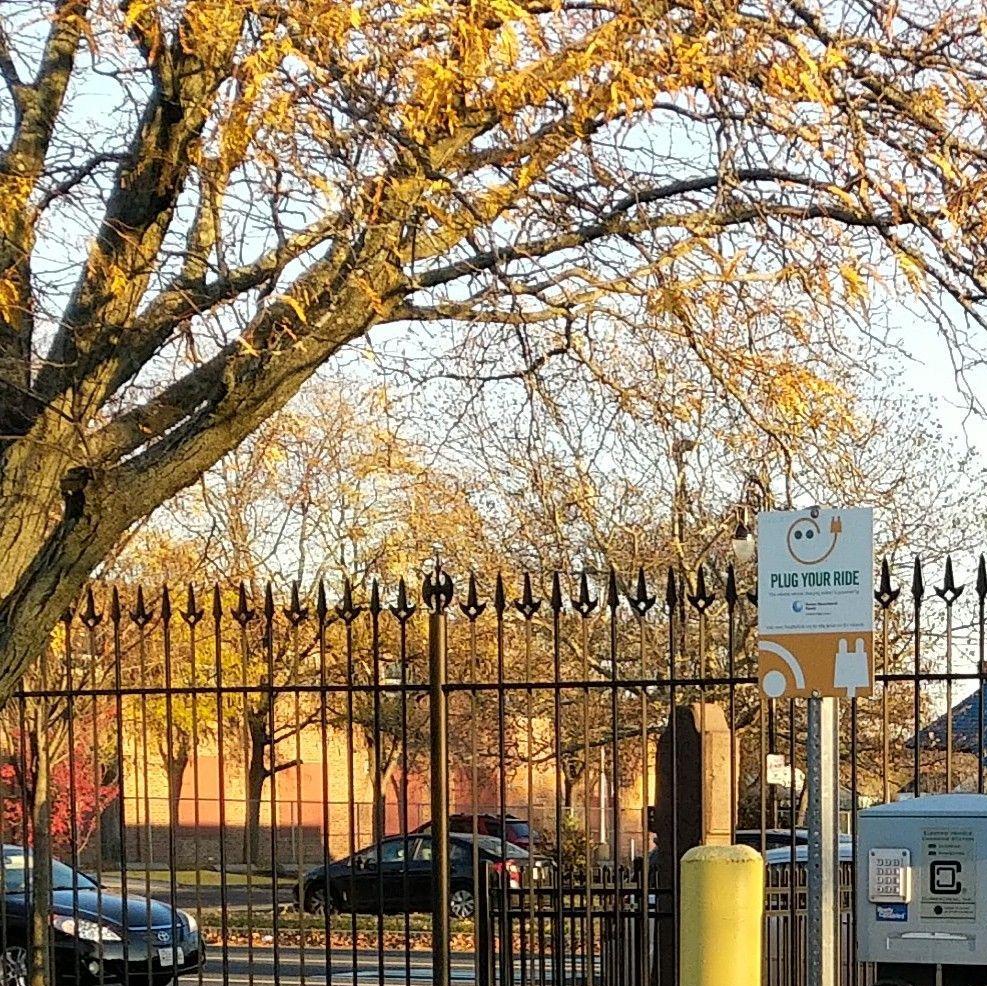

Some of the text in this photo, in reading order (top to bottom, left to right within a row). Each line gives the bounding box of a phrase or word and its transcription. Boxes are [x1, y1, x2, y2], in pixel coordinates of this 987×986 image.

[771, 570, 859, 588] PLUG YOUR RIDE
